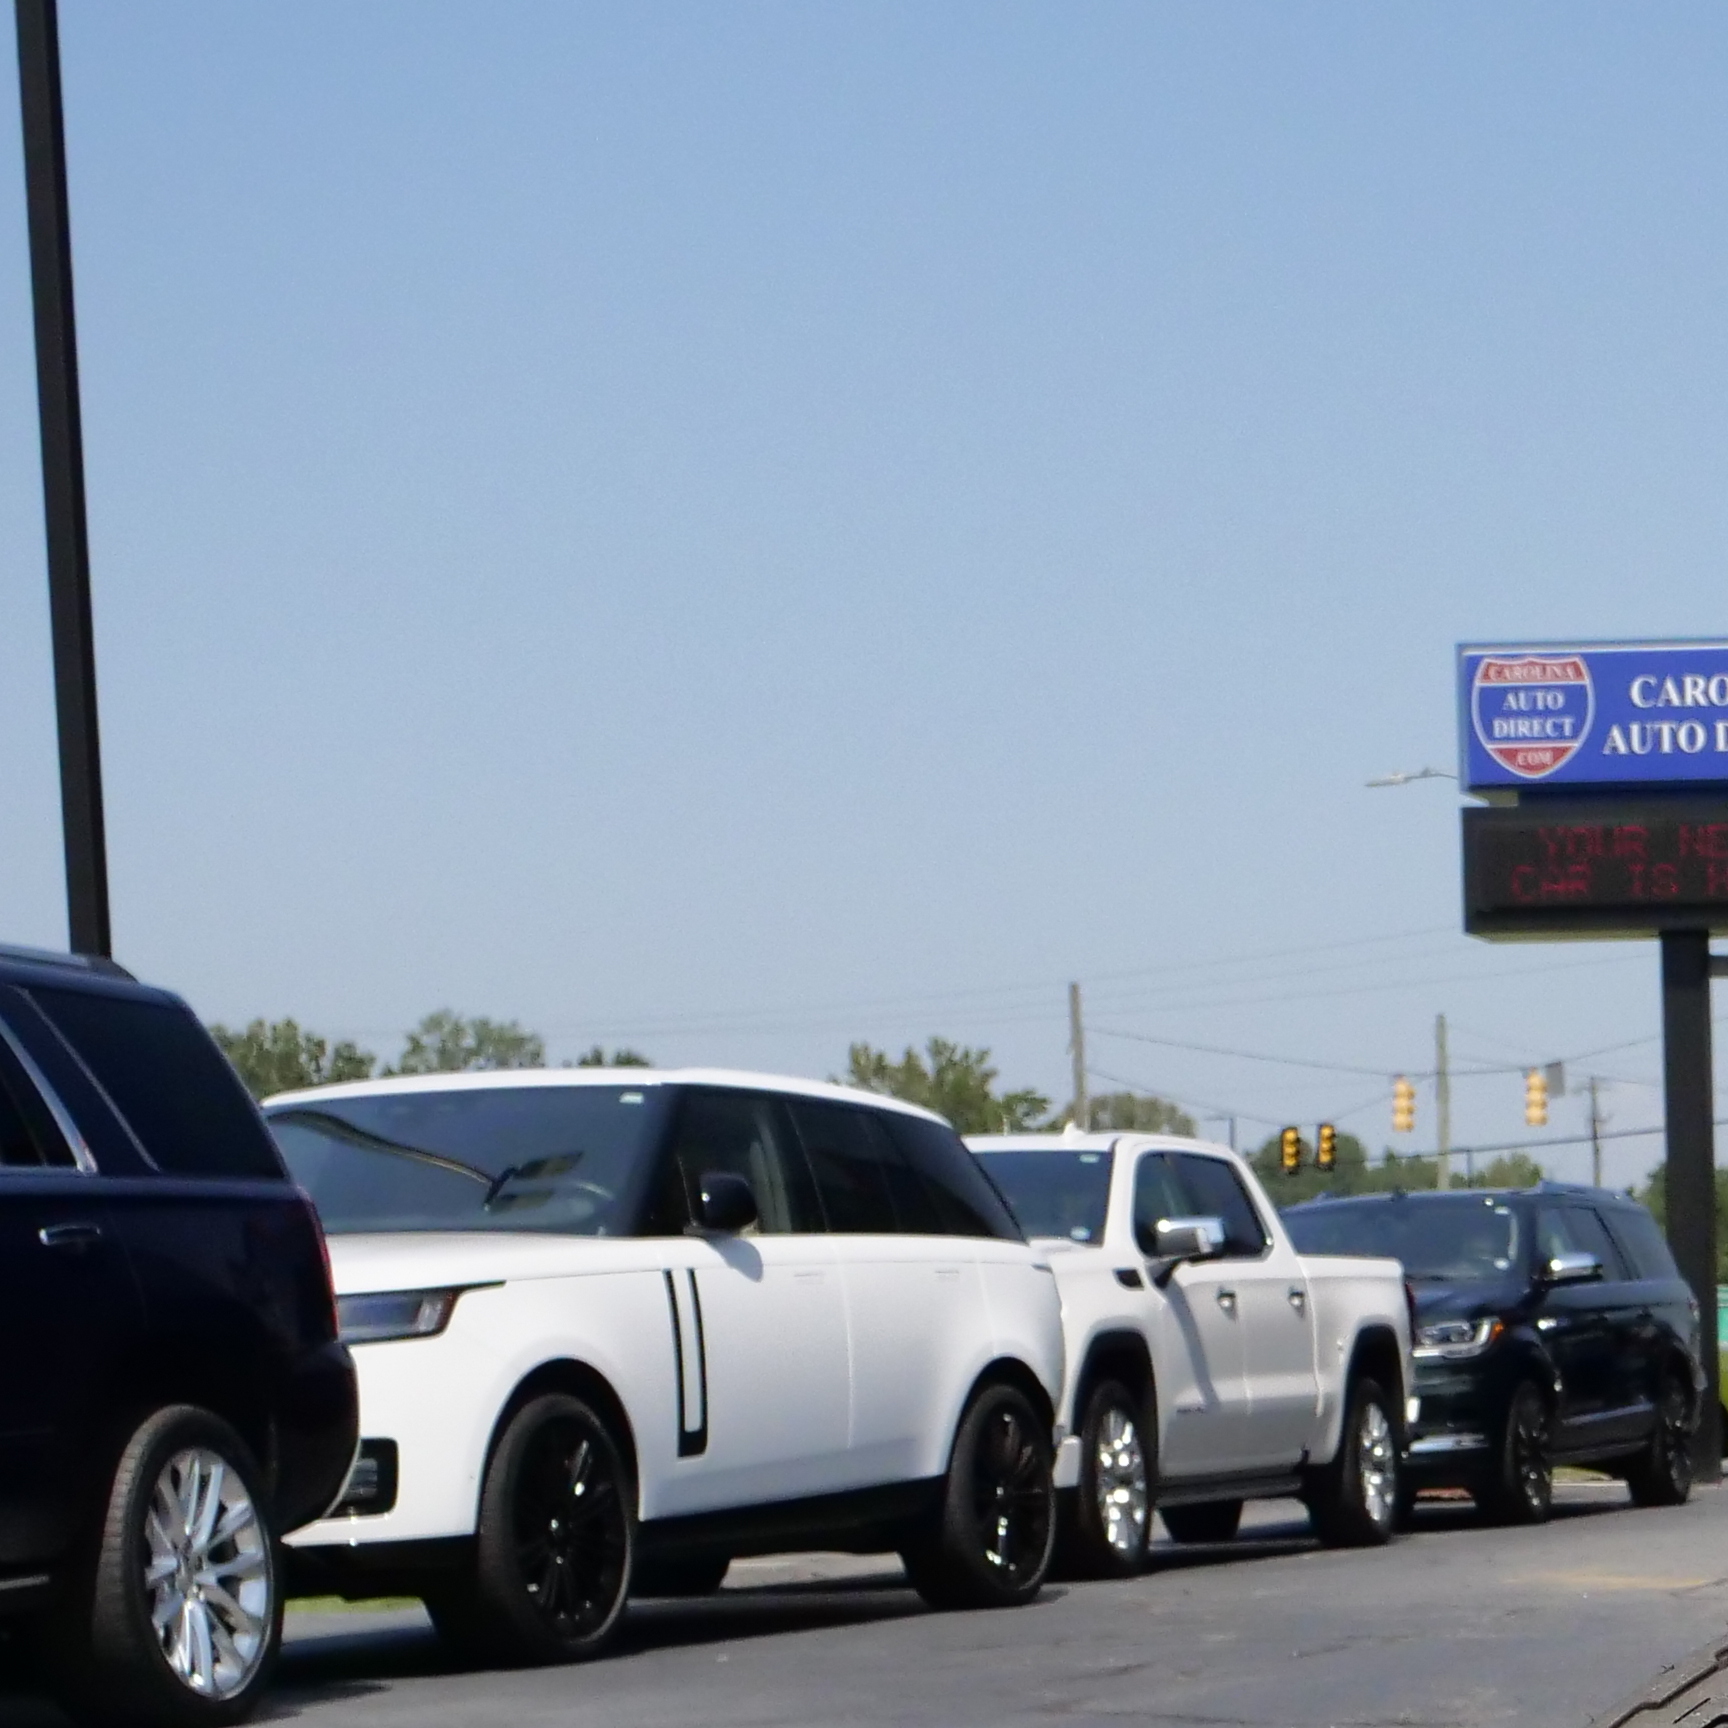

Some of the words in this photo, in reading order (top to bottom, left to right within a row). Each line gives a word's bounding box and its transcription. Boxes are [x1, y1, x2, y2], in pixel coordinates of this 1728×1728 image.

[1487, 663, 1576, 682] CAROLINA
[1502, 690, 1565, 711] AUTO
[1492, 715, 1576, 738] DIRECT
[1602, 719, 1708, 755] AUTO
